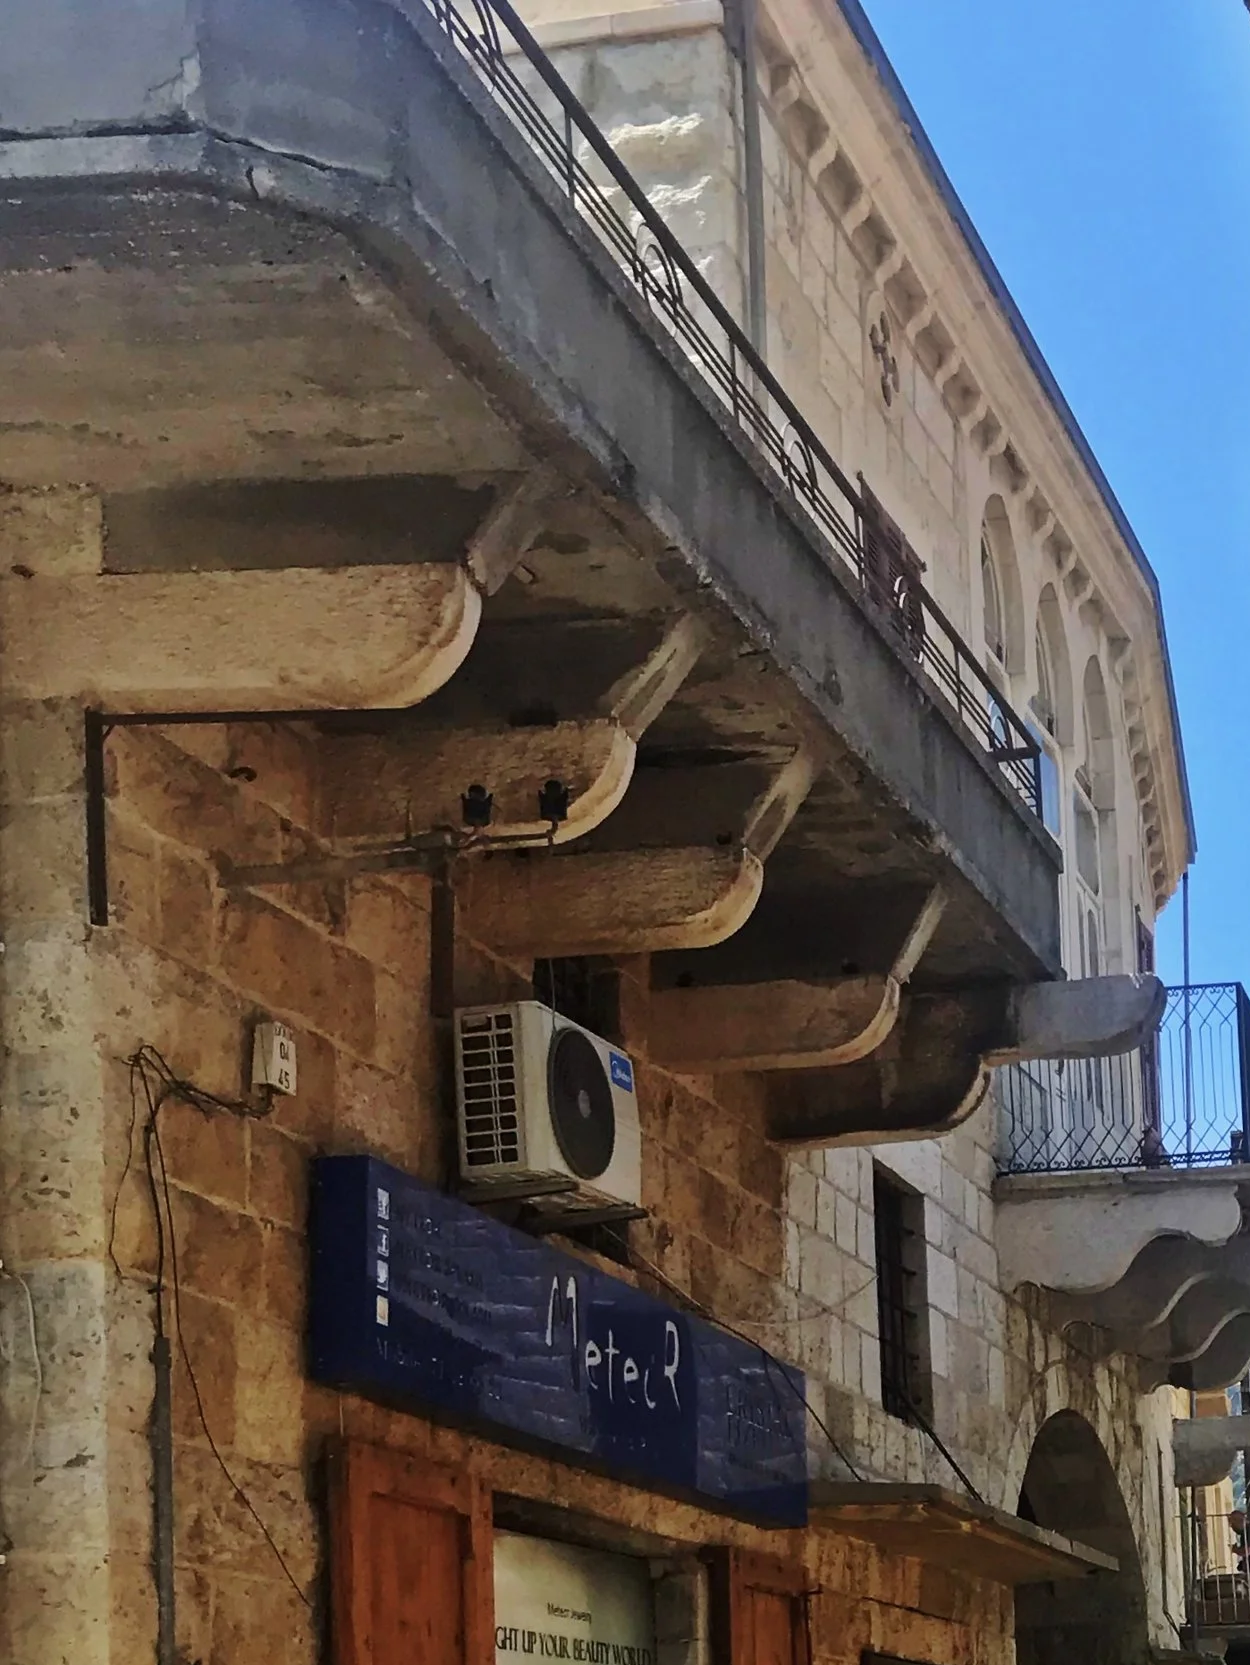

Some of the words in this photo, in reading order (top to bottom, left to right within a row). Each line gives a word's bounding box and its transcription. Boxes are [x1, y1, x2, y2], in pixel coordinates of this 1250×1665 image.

[522, 1629, 537, 1655] UP
[539, 1632, 571, 1660] YOUR
[573, 1638, 611, 1665] BEAUTY
